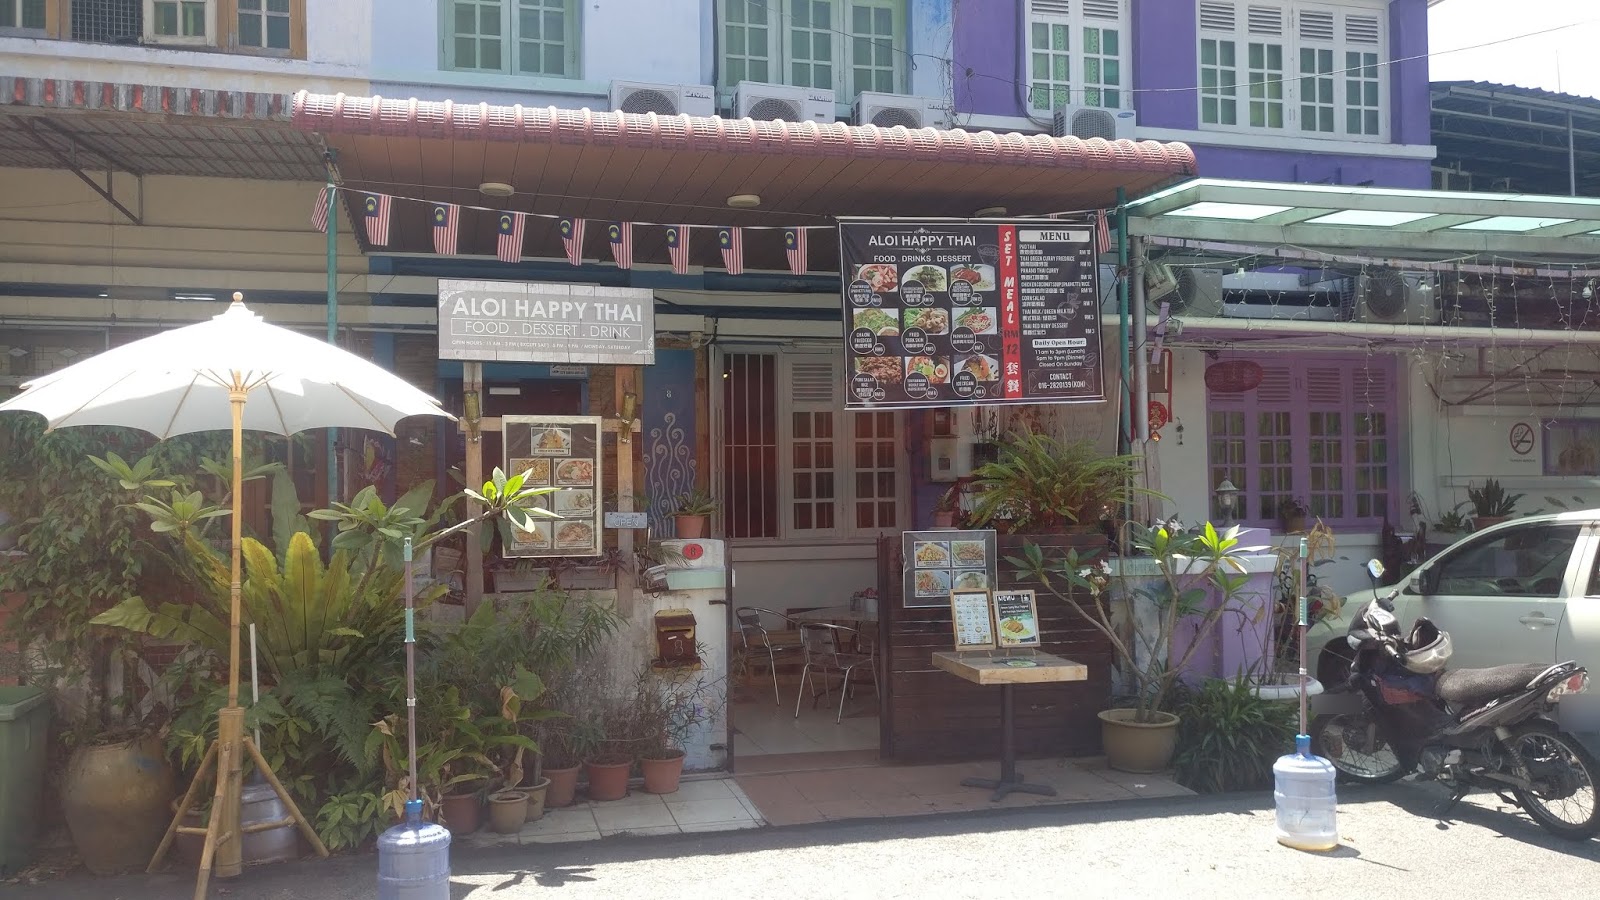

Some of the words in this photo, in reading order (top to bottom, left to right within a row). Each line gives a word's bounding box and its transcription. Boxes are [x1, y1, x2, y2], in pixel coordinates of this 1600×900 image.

[868, 235, 898, 246] ALOI
[902, 235, 944, 246] HAPPY
[946, 236, 976, 246] THAI
[1040, 232, 1070, 240] MENU
[1004, 231, 1012, 266] SET
[1004, 276, 1015, 324] MEAL
[452, 297, 506, 317] ALOI
[515, 300, 588, 319] HAPPY
[594, 302, 642, 322] THAI
[465, 321, 510, 334] FOOD
[522, 324, 578, 336] DESSERT
[590, 326, 631, 338] DRINK
[1006, 344, 1018, 354] 12
[666, 390, 671, 398] 8
